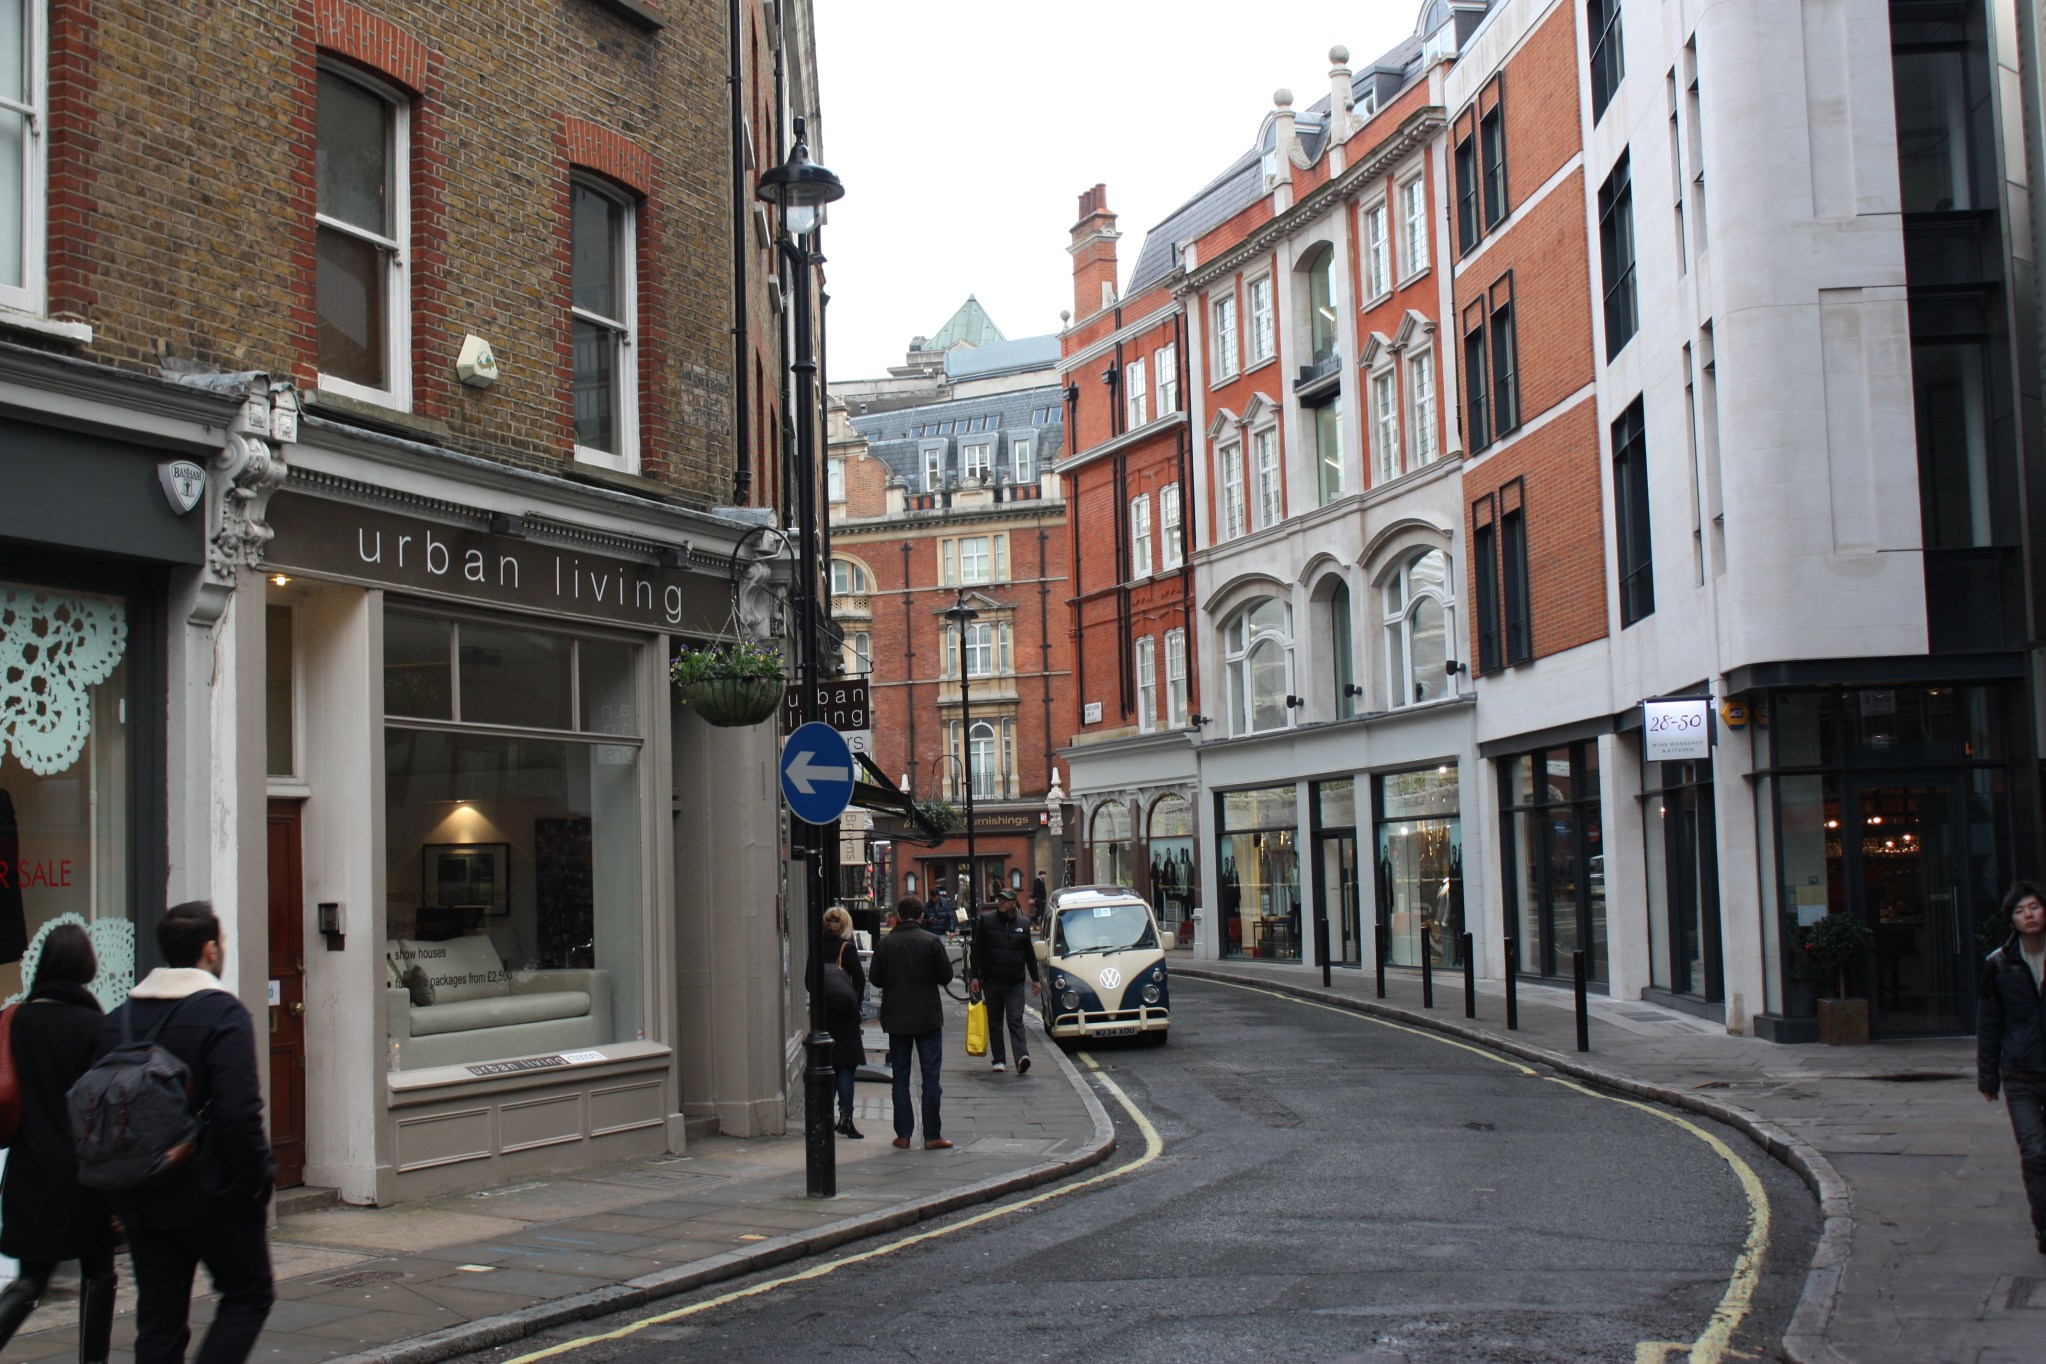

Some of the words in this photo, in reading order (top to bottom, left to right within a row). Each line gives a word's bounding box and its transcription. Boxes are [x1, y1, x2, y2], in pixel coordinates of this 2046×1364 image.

[174, 467, 202, 480] BANHAM
[358, 527, 519, 589] urban
[555, 556, 683, 624] living
[788, 688, 864, 708] uban
[789, 707, 863, 727] liing
[846, 814, 857, 861] Browns
[18, 859, 72, 888] SALE
[395, 950, 416, 960] show
[418, 947, 447, 958] houses
[430, 974, 467, 988] packages
[468, 971, 486, 984] from
[487, 970, 513, 984] £2,500
[471, 1060, 519, 1075] urban
[520, 1054, 568, 1067] living
